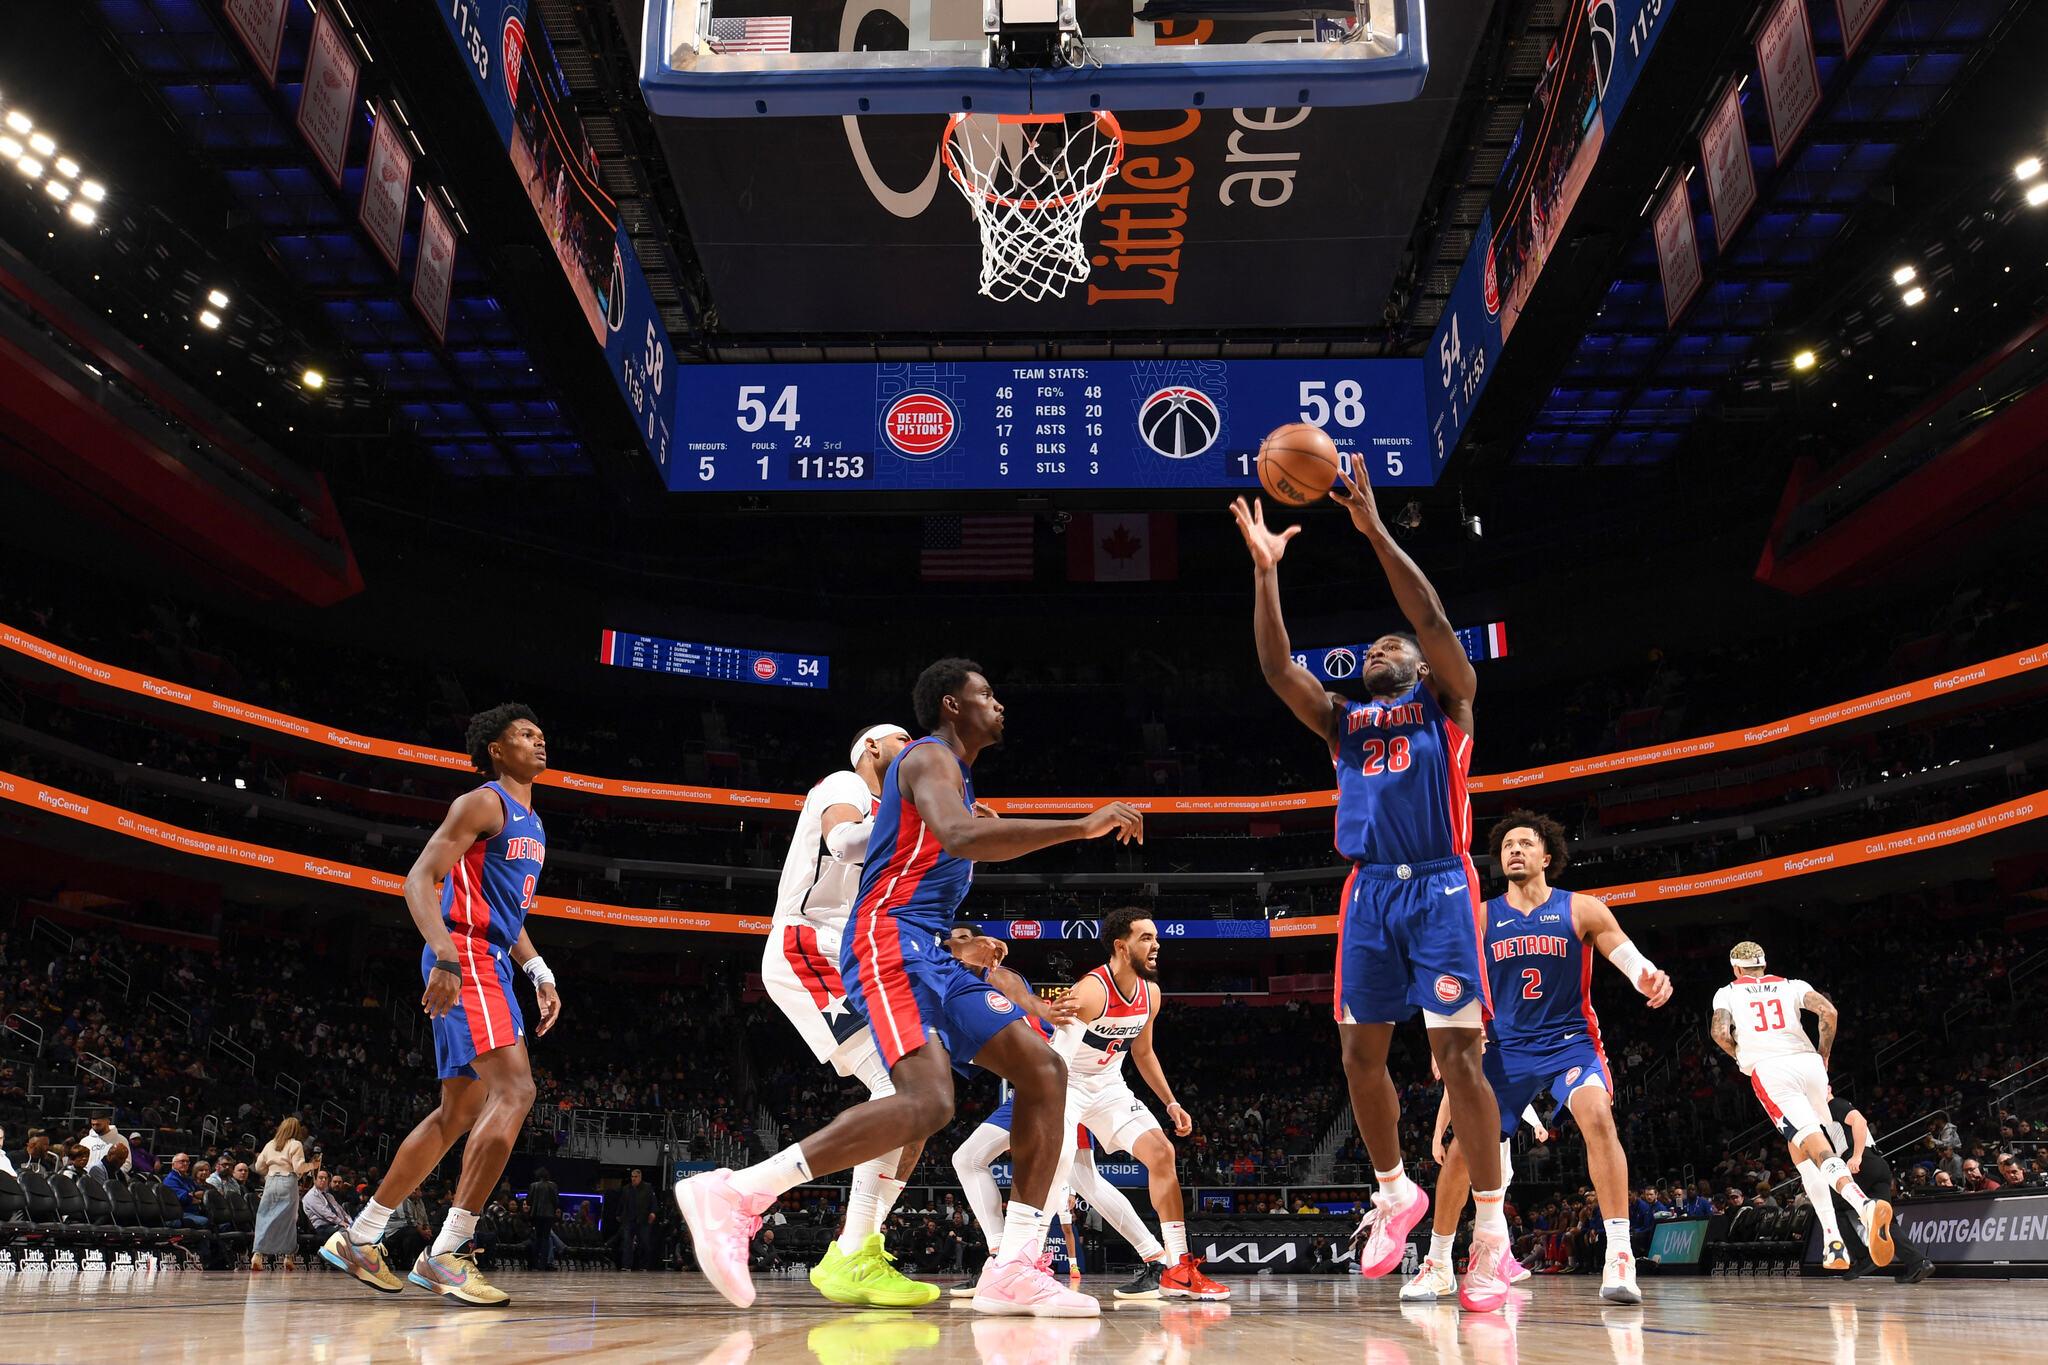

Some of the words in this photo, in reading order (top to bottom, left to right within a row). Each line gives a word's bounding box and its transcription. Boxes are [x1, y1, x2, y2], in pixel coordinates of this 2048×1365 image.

[1088, 156, 1196, 306] Little
[645, 318, 663, 396] 58
[1440, 312, 1460, 388] 54
[1013, 369, 1044, 379] TEAM
[1049, 368, 1089, 379] STATS:
[1463, 348, 1485, 404] 11:53
[624, 359, 643, 413] 11:53
[996, 387, 1013, 399] 46
[1037, 387, 1064, 398] FG%
[1084, 386, 1102, 399] 48
[736, 385, 801, 433] 54
[996, 406, 1013, 418] 26
[1036, 406, 1066, 416] REBS
[1085, 405, 1102, 417] 20
[1300, 379, 1366, 429] 58
[897, 412, 943, 423] DETROIT
[897, 424, 943, 435] PISTONS
[996, 424, 1013, 437] 17
[1036, 424, 1066, 435] ASTS
[1085, 423, 1102, 436] 16
[688, 442, 728, 450] TIMEOUTS:
[751, 442, 778, 450] FOULS:
[794, 435, 811, 448] 24
[823, 441, 842, 450] 3rd
[1000, 443, 1008, 455] 6
[1036, 443, 1066, 454] BLKS
[1090, 443, 1098, 455] 4
[1330, 438, 1356, 447] OULS:
[1372, 437, 1413, 446] TIMEOUTS:
[1437, 431, 1444, 459] 5
[660, 438, 666, 464] 5
[699, 456, 715, 481] 5
[756, 456, 769, 480] 1
[797, 456, 864, 478] 11:53
[1000, 462, 1008, 475] 5
[1036, 462, 1066, 473] STLS
[1090, 461, 1098, 474] 3
[1387, 451, 1403, 476] 5
[4, 632, 20, 645] and
[21, 639, 57, 660] message
[58, 653, 68, 665] all
[69, 658, 77, 668] in
[78, 662, 92, 674] one
[93, 666, 111, 680] app
[2018, 654, 2041, 666] Call,
[798, 659, 819, 677] 54
[1933, 669, 1986, 690] RingCentral
[142, 680, 192, 702] RingCentral
[212, 700, 244, 716] Simpler
[245, 709, 309, 733] communications
[1809, 710, 1840, 725] Simpler
[1841, 691, 1912, 716] communications
[327, 731, 370, 749] RingCentral
[1744, 724, 1790, 742] RingCentral
[398, 747, 415, 758] Call,
[416, 751, 438, 762] meet,
[439, 754, 455, 764] and
[1362, 736, 1411, 776] 28
[1569, 764, 1586, 774] Call,
[1587, 761, 1609, 771] meet,
[1610, 757, 1625, 767] and
[1626, 750, 1661, 765] message
[1662, 748, 1673, 757] all
[1682, 743, 1698, 753] one
[1698, 741, 1715, 753] app
[563, 775, 604, 790] RingCentral
[1502, 772, 1544, 786] RingCentral
[622, 785, 650, 796] Simpler
[651, 787, 712, 799] communications
[729, 792, 771, 804] RingCentral
[38, 791, 89, 815] RingCentral
[1006, 801, 1033, 811] Simpler
[1034, 801, 1093, 810] communications
[1175, 802, 1192, 810] Call,
[1214, 801, 1227, 809] and
[1229, 801, 1259, 811] message
[1293, 798, 1307, 806] app
[1865, 843, 1887, 854] Call,
[1888, 837, 1915, 849] meet,
[1917, 831, 1936, 843] and
[1938, 820, 1975, 839] message
[1977, 816, 1988, 828] all
[1998, 811, 2015, 822] one
[2016, 804, 2033, 818] app
[118, 816, 136, 830] Call,
[137, 823, 159, 837] meet,
[161, 829, 176, 841] and
[176, 835, 216, 853] message
[217, 842, 229, 854] all
[230, 846, 238, 856] in
[240, 848, 256, 860] one
[258, 852, 274, 865] app
[506, 837, 546, 865] DETRO
[304, 861, 351, 879] RingCentral
[1784, 853, 1834, 870] RingCentral
[371, 877, 401, 889] Simpler
[1658, 882, 1692, 895] Simpler
[1694, 868, 1763, 889] communications
[521, 874, 535, 909] 9
[565, 905, 583, 916] Call,
[584, 908, 606, 918] meet,
[607, 910, 622, 920] and
[622, 913, 658, 924] message
[659, 915, 669, 924] all
[679, 917, 694, 925] one
[695, 918, 710, 927] app
[1539, 914, 1560, 922] UWM
[1165, 924, 1185, 935] 48
[1491, 935, 1568, 962] DETROIT
[1522, 968, 1542, 999] 2
[1750, 998, 1786, 1032] 33
[1095, 1021, 1144, 1036] wizards
[1097, 1164, 1139, 1175] RTSIDE
[1908, 1217, 2007, 1243] MORTGAGE
[2009, 1215, 2048, 1241] LEN
[1663, 1230, 1695, 1255] UWM
[25, 1249, 44, 1261] Little
[55, 1249, 75, 1261] Little
[85, 1249, 103, 1261] Little
[115, 1252, 132, 1263] Little
[1205, 1243, 1296, 1263] KIA
[20, 1260, 49, 1271] Caesars
[51, 1261, 79, 1272] Caesars
[82, 1260, 107, 1271] Caesars
[111, 1263, 135, 1272] Caesars
